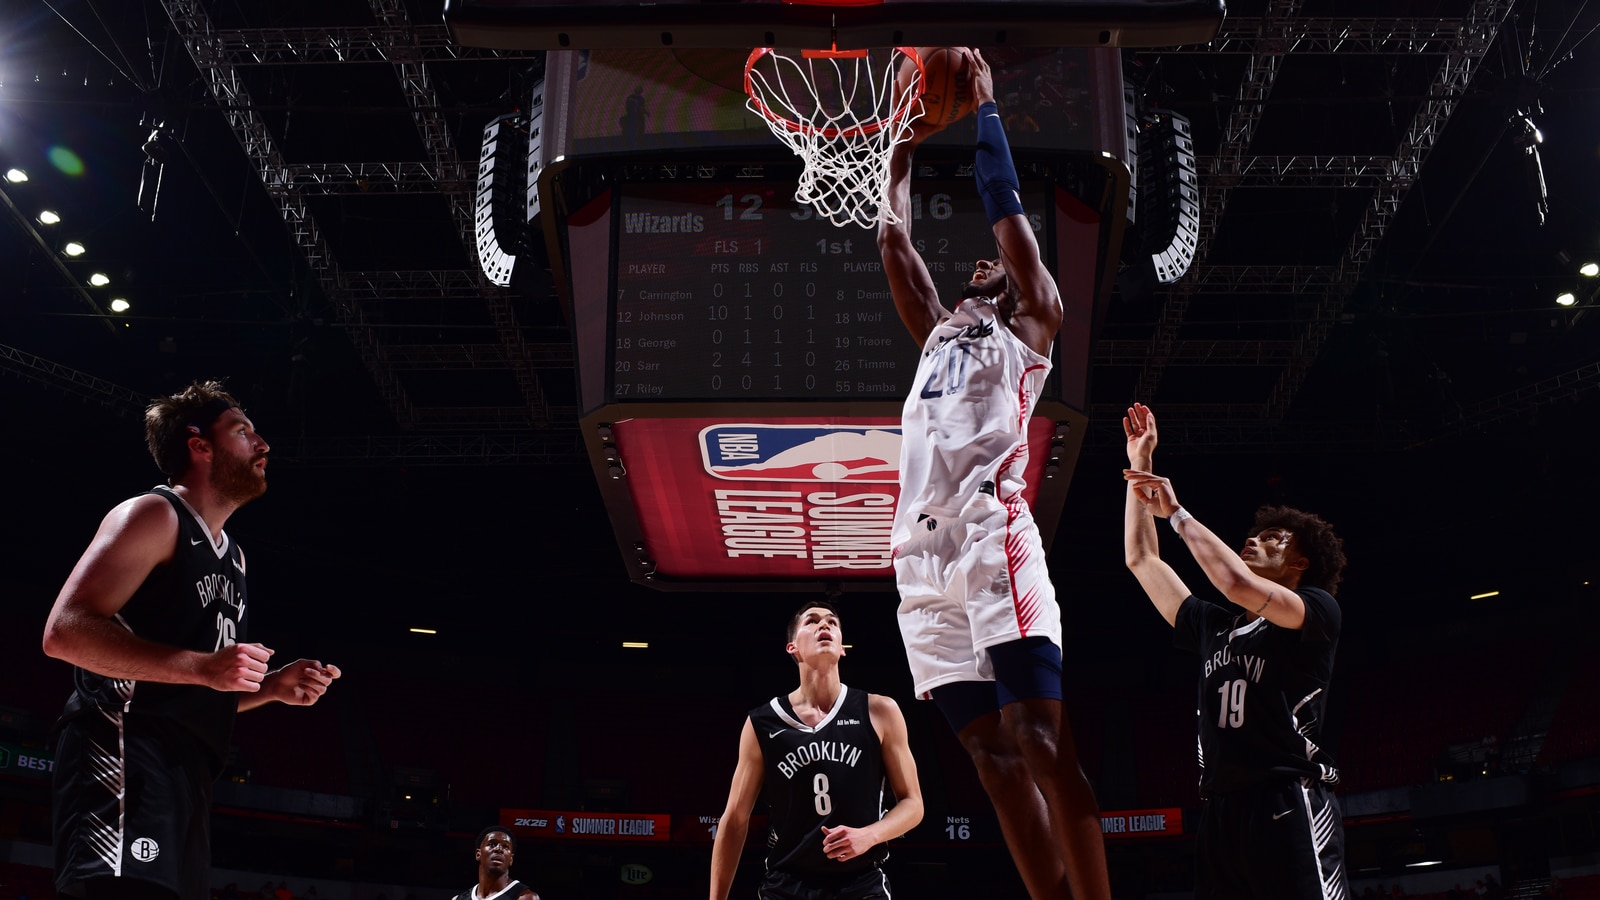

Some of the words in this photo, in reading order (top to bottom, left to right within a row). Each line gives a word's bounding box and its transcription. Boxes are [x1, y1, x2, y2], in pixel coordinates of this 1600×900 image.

[715, 193, 763, 220] 12
[911, 193, 953, 220] 16
[624, 211, 705, 234] Wizards
[714, 240, 739, 254] FLS
[754, 239, 762, 255] 1
[816, 238, 853, 254] 1st
[937, 238, 949, 254] 2
[628, 264, 666, 274] PLAYER
[711, 263, 730, 273] PTS
[738, 263, 759, 273] RBS
[769, 262, 790, 273] AST
[800, 262, 818, 273] FLS
[843, 262, 881, 273] PLAYER
[928, 262, 946, 272] PTS
[954, 261, 975, 272] RBS
[617, 289, 625, 300] 7
[639, 290, 693, 301] Carrington
[713, 282, 723, 298] 0
[744, 282, 752, 298] 1
[773, 282, 783, 298] 0
[805, 282, 816, 298] 0
[836, 290, 845, 300] 8
[616, 311, 632, 323] 12
[639, 312, 684, 322] Johnson
[708, 305, 728, 320] 10
[744, 305, 752, 320] 1
[773, 305, 783, 320] 0
[807, 305, 815, 320] 1
[835, 313, 850, 324] 18
[857, 312, 883, 322] Wolf
[616, 338, 631, 349] 18
[638, 338, 677, 350] George
[712, 329, 722, 344] 0
[744, 329, 752, 344] 1
[774, 329, 782, 344] 1
[807, 329, 815, 344] 1
[835, 337, 850, 348] 19
[857, 336, 892, 346] Traore
[615, 361, 631, 372] 20
[637, 361, 660, 371] Sarr
[712, 352, 722, 367] 2
[741, 352, 752, 367] 4
[774, 352, 782, 367] 1
[805, 351, 816, 367] 0
[834, 360, 850, 371] 26
[857, 359, 896, 369] Timme
[920, 343, 972, 399] 20
[615, 384, 631, 395] 27
[637, 384, 664, 397] Riley
[711, 375, 722, 390] 0
[741, 375, 752, 390] 0
[774, 375, 782, 390] 1
[805, 374, 816, 390] 0
[835, 381, 851, 392] 55
[857, 382, 896, 392] Bamba
[717, 433, 760, 461] NBA
[714, 489, 808, 559] LEAGUE
[806, 491, 896, 570] SUMMER
[214, 611, 237, 652] 26
[1217, 679, 1248, 729] 19
[17, 754, 55, 772] BEST
[777, 740, 862, 780] BROOKLYN
[812, 772, 832, 817] 8
[514, 818, 548, 828] 2K26
[572, 817, 616, 835] SUMMER
[618, 819, 656, 836] LEAGUE
[946, 816, 970, 824] Nets
[1128, 814, 1167, 832] LEAGUE
[945, 824, 971, 840] 16
[627, 868, 648, 882] Lite
